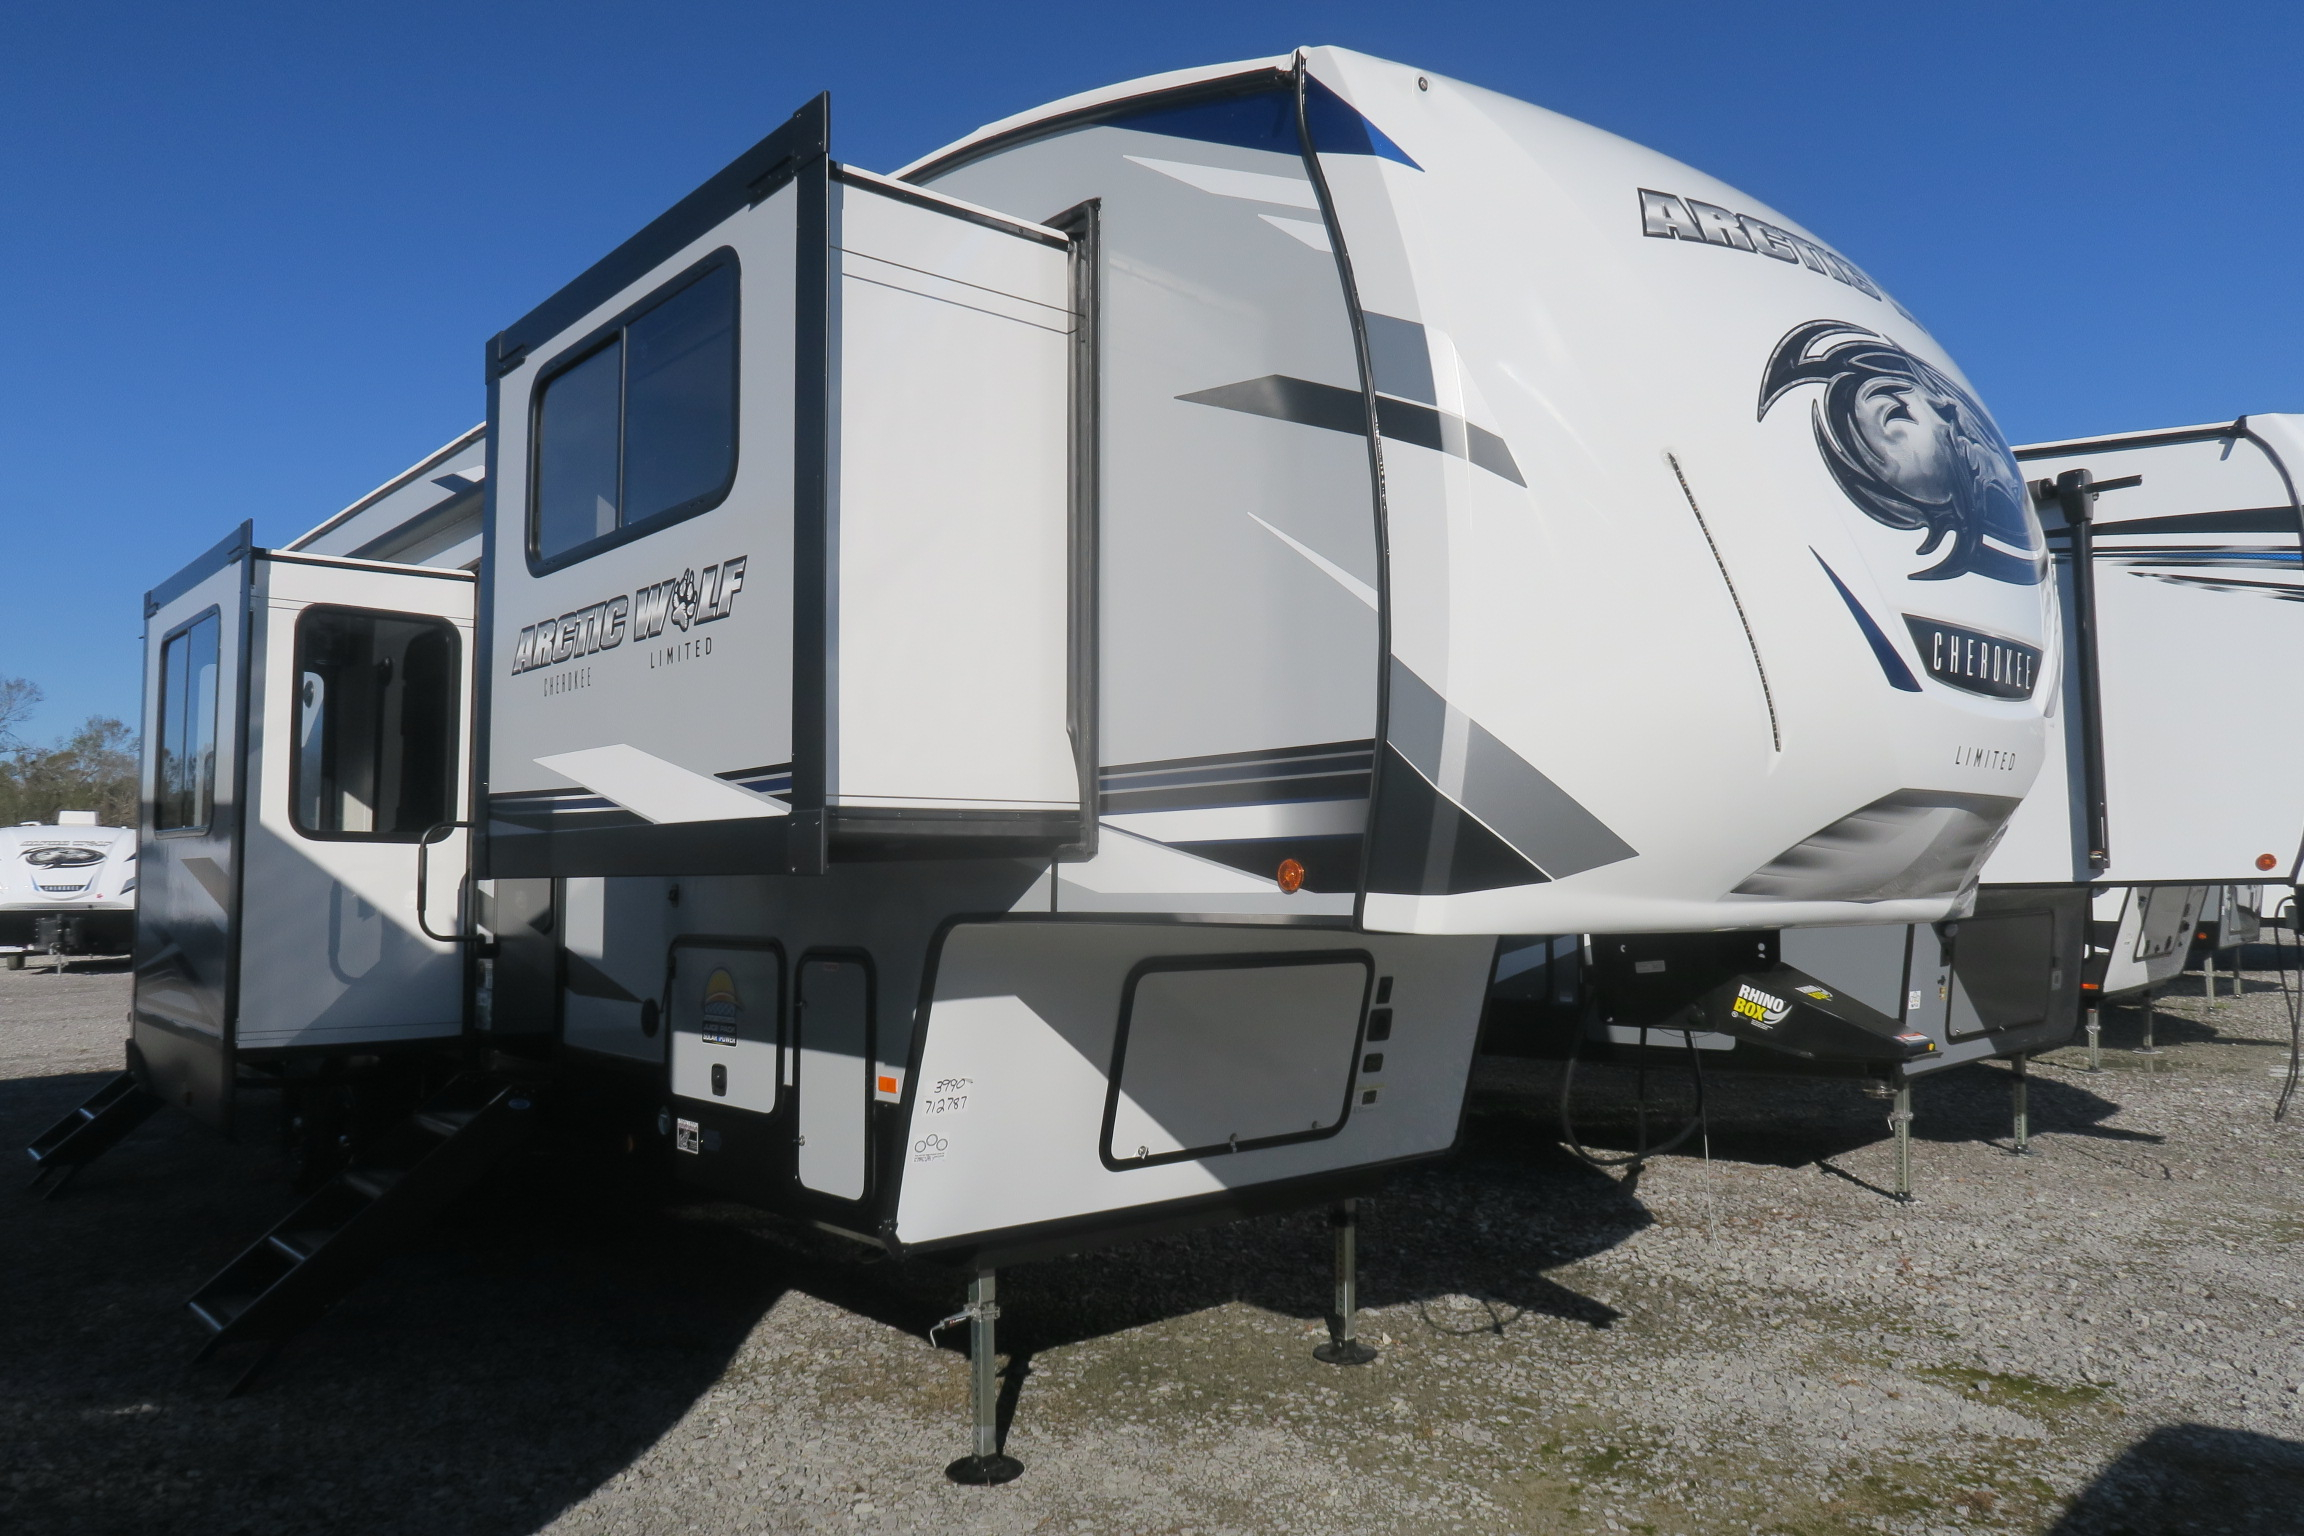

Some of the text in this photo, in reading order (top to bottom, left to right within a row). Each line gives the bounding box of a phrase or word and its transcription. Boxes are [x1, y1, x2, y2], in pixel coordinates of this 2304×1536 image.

[1637, 187, 1882, 302] ARCTIC
[511, 594, 629, 677] ARCTIC
[650, 636, 713, 669] LIMITED
[1933, 631, 2032, 690] CHEROKEE
[543, 666, 591, 697] CHEROKEE
[1955, 745, 2016, 771] LIMITED
[1733, 996, 1767, 1022] BOX
[1738, 983, 1785, 1013] RHINO
